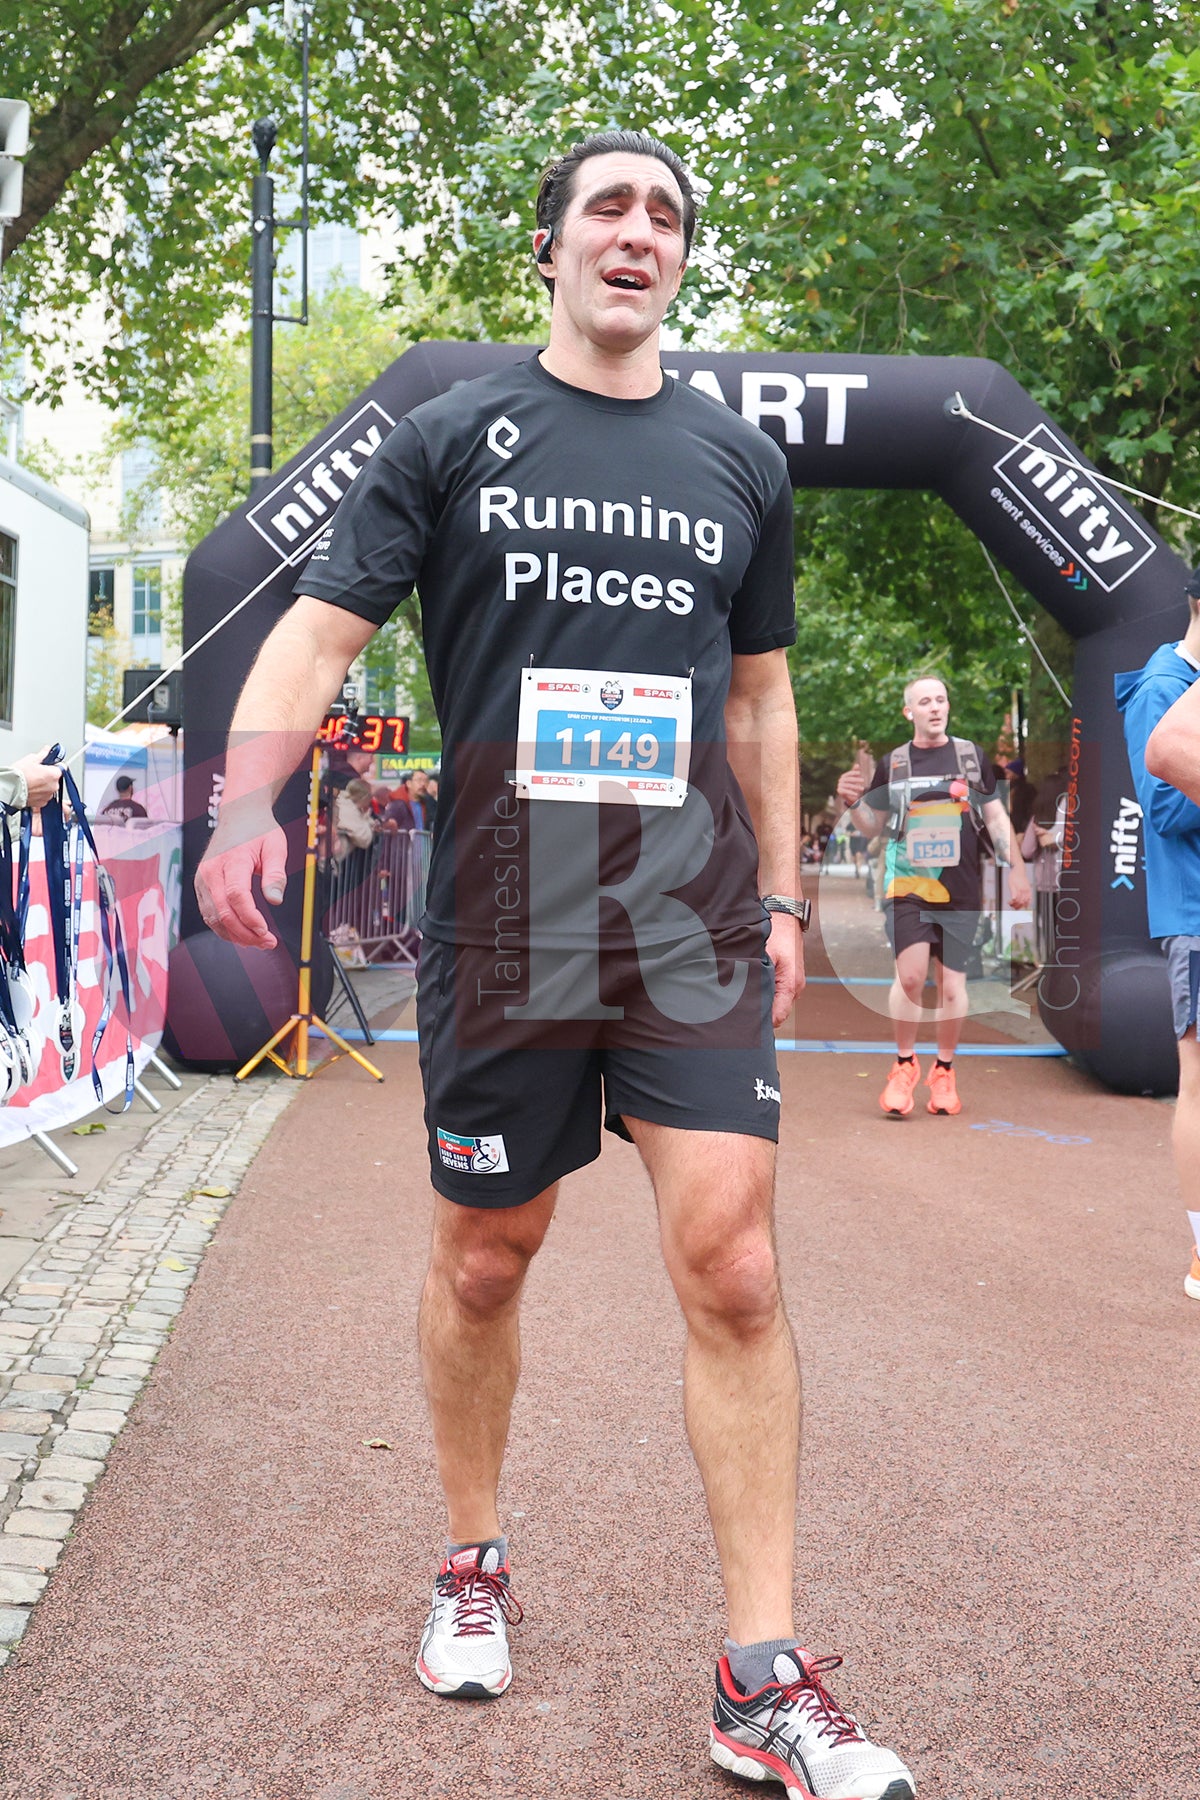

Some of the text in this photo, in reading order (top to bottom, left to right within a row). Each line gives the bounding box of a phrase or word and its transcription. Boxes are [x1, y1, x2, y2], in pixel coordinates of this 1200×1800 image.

[663, 370, 868, 445] ART
[479, 485, 724, 565] Running
[990, 487, 1065, 566] event services
[1018, 449, 1134, 563] nifty
[505, 552, 695, 616] Places
[547, 683, 580, 692] SPAR
[643, 689, 673, 698] SPAR
[555, 727, 660, 770] 1149
[541, 776, 575, 785] SPAR
[637, 782, 667, 791] SPAR
[917, 843, 950, 858] 1540
[1110, 797, 1144, 875] nifty
[442, 1155, 469, 1170] SEVENS
